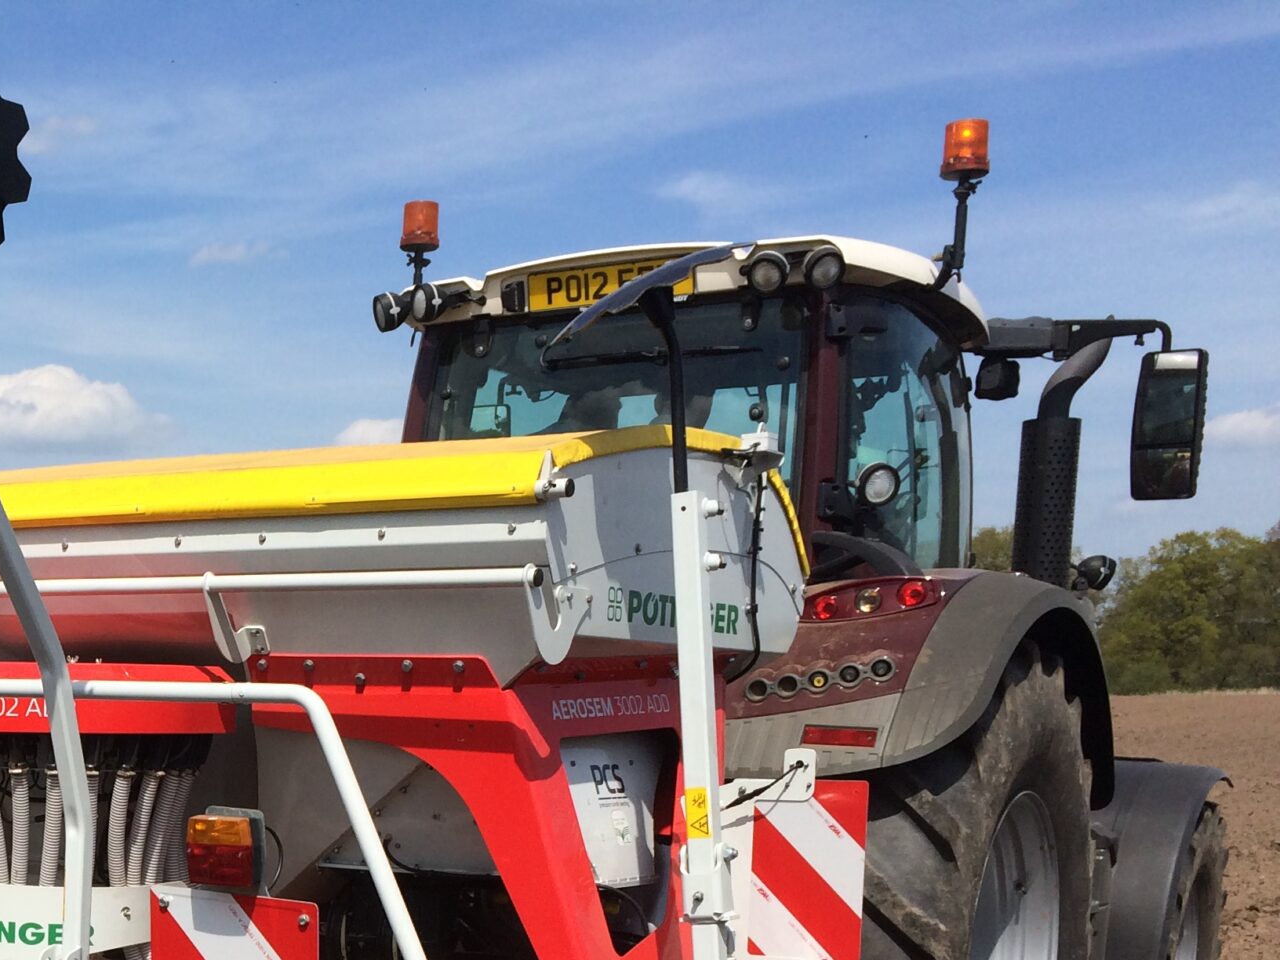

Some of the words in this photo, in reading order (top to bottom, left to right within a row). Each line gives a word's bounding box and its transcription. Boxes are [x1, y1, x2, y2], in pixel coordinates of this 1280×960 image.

[546, 270, 609, 305] PO12
[627, 589, 739, 635] PÖTTER
[552, 697, 614, 720] AEROSEM
[613, 694, 646, 716] 3002
[646, 693, 670, 713] ADD
[589, 763, 626, 795] PCS
